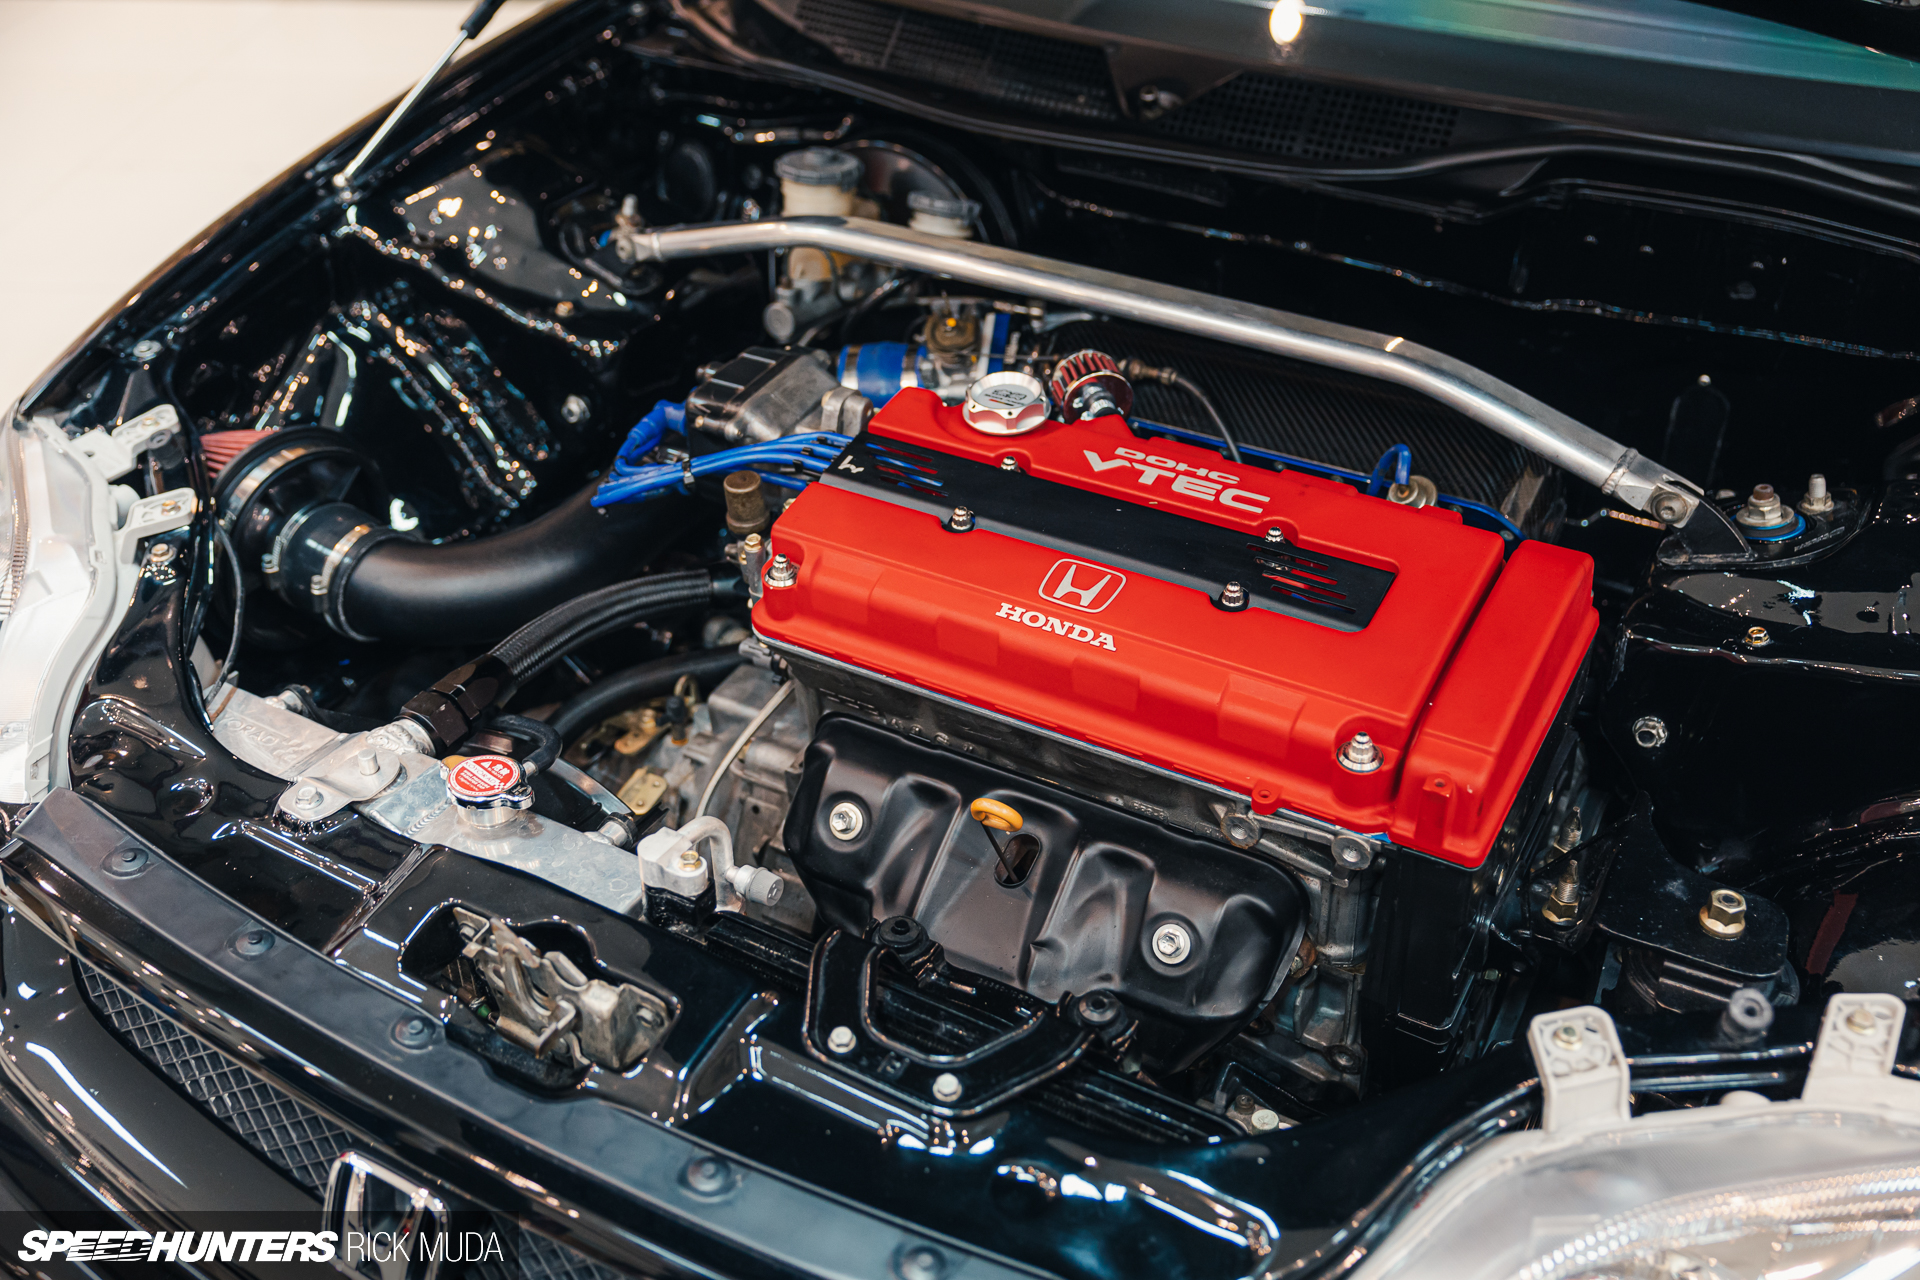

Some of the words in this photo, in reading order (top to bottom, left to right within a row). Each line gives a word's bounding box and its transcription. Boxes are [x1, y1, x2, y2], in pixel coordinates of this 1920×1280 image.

[1083, 450, 1271, 514] VTEC
[1114, 447, 1240, 484] DOHC
[995, 602, 1117, 651] HONDA
